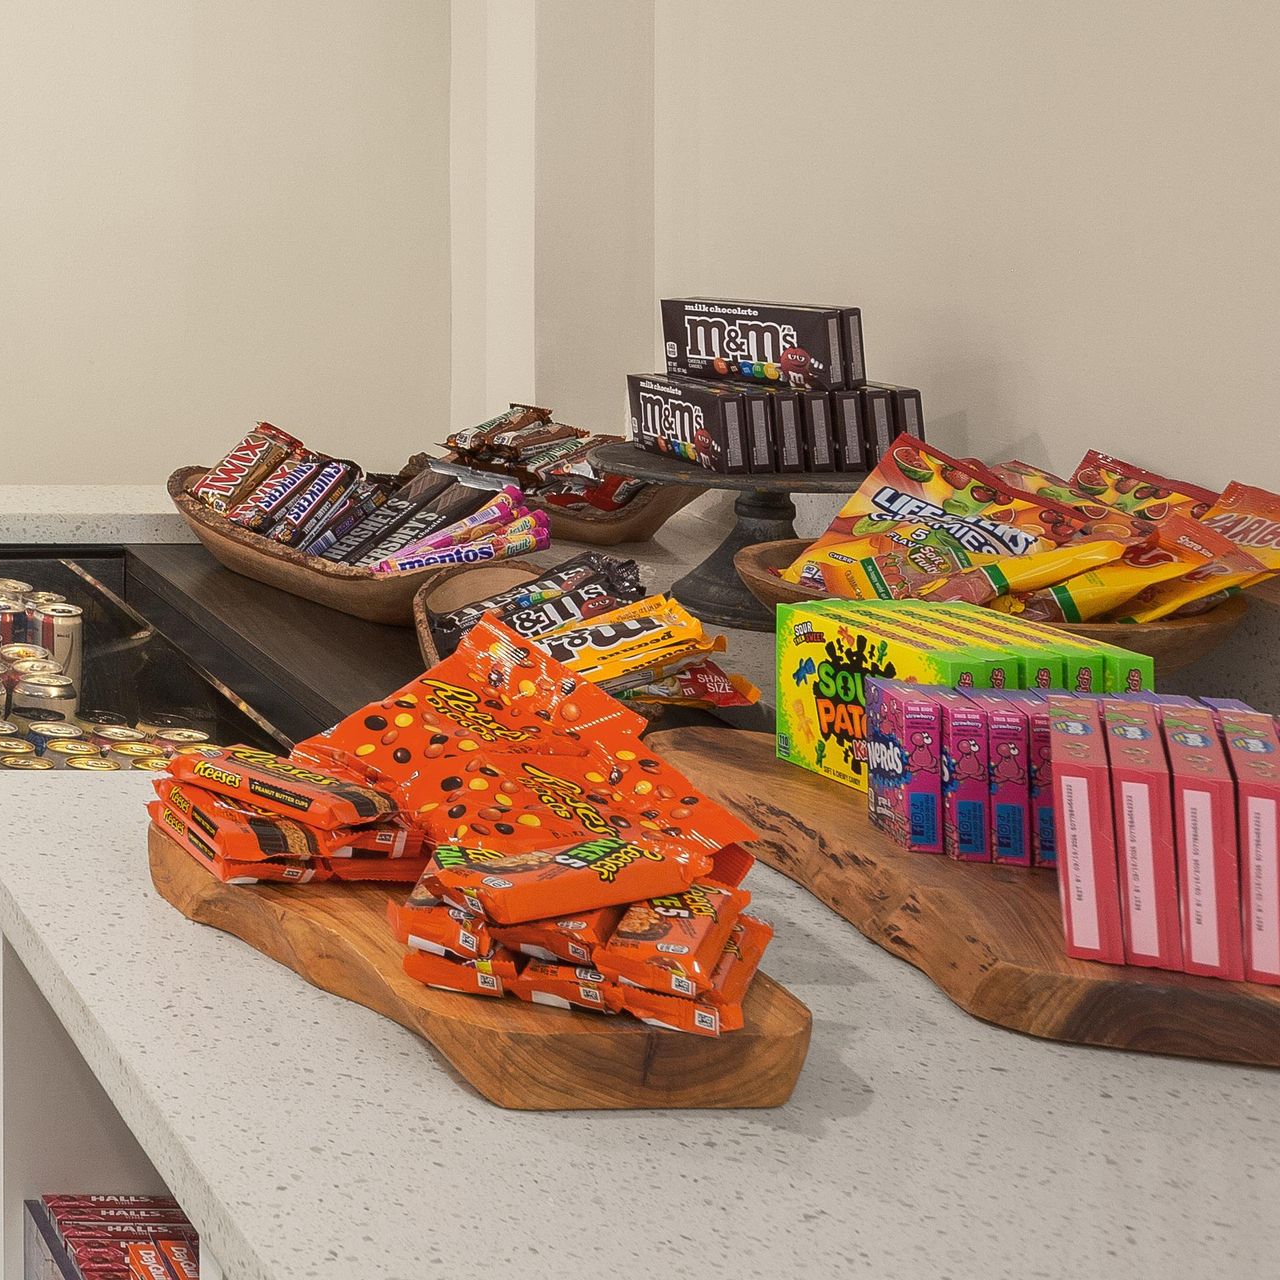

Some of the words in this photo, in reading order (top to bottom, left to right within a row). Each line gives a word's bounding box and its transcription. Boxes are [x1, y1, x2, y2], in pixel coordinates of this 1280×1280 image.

[685, 303, 708, 313] milk
[708, 305, 759, 317] chocolate
[640, 380, 654, 389] milk
[654, 384, 682, 396] chocolate
[194, 436, 270, 496] TWIX
[260, 462, 317, 511] SNICKERS
[291, 463, 344, 523] SNICKERS
[911, 527, 930, 540] 5
[506, 539, 532, 556] fruit
[1177, 535, 1198, 552] Share
[398, 543, 494, 571] mentos
[829, 552, 857, 564] CHERRY
[794, 622, 813, 636] SOUR
[706, 681, 733, 694] SIZE
[255, 785, 275, 796] PEANUT
[275, 790, 294, 804] BUTTER
[294, 798, 308, 808] CUPS
